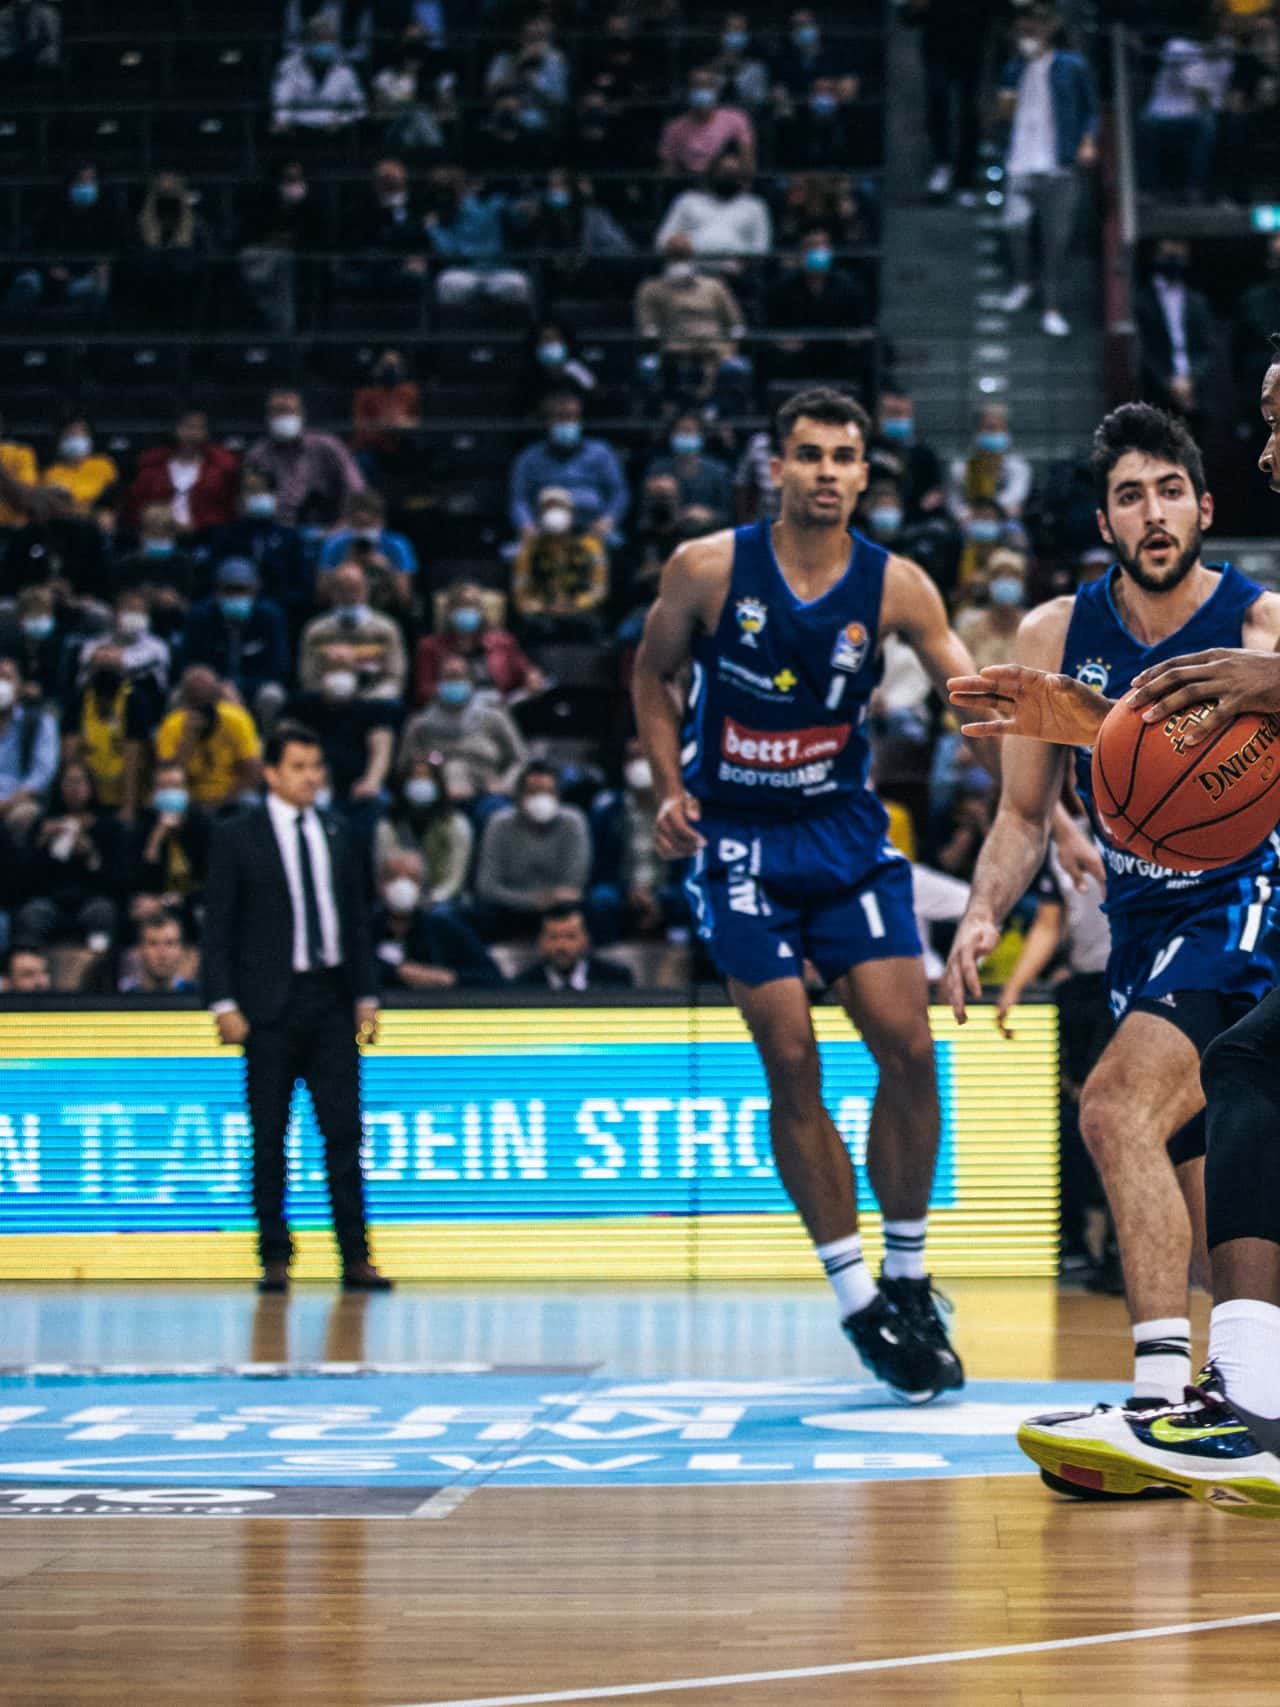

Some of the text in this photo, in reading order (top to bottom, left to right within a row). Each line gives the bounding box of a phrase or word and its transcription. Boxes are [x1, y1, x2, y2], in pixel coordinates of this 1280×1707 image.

[860, 891, 886, 939] 1
[360, 1099, 546, 1181] DEIN
[264, 1452, 951, 1471] SWLB
